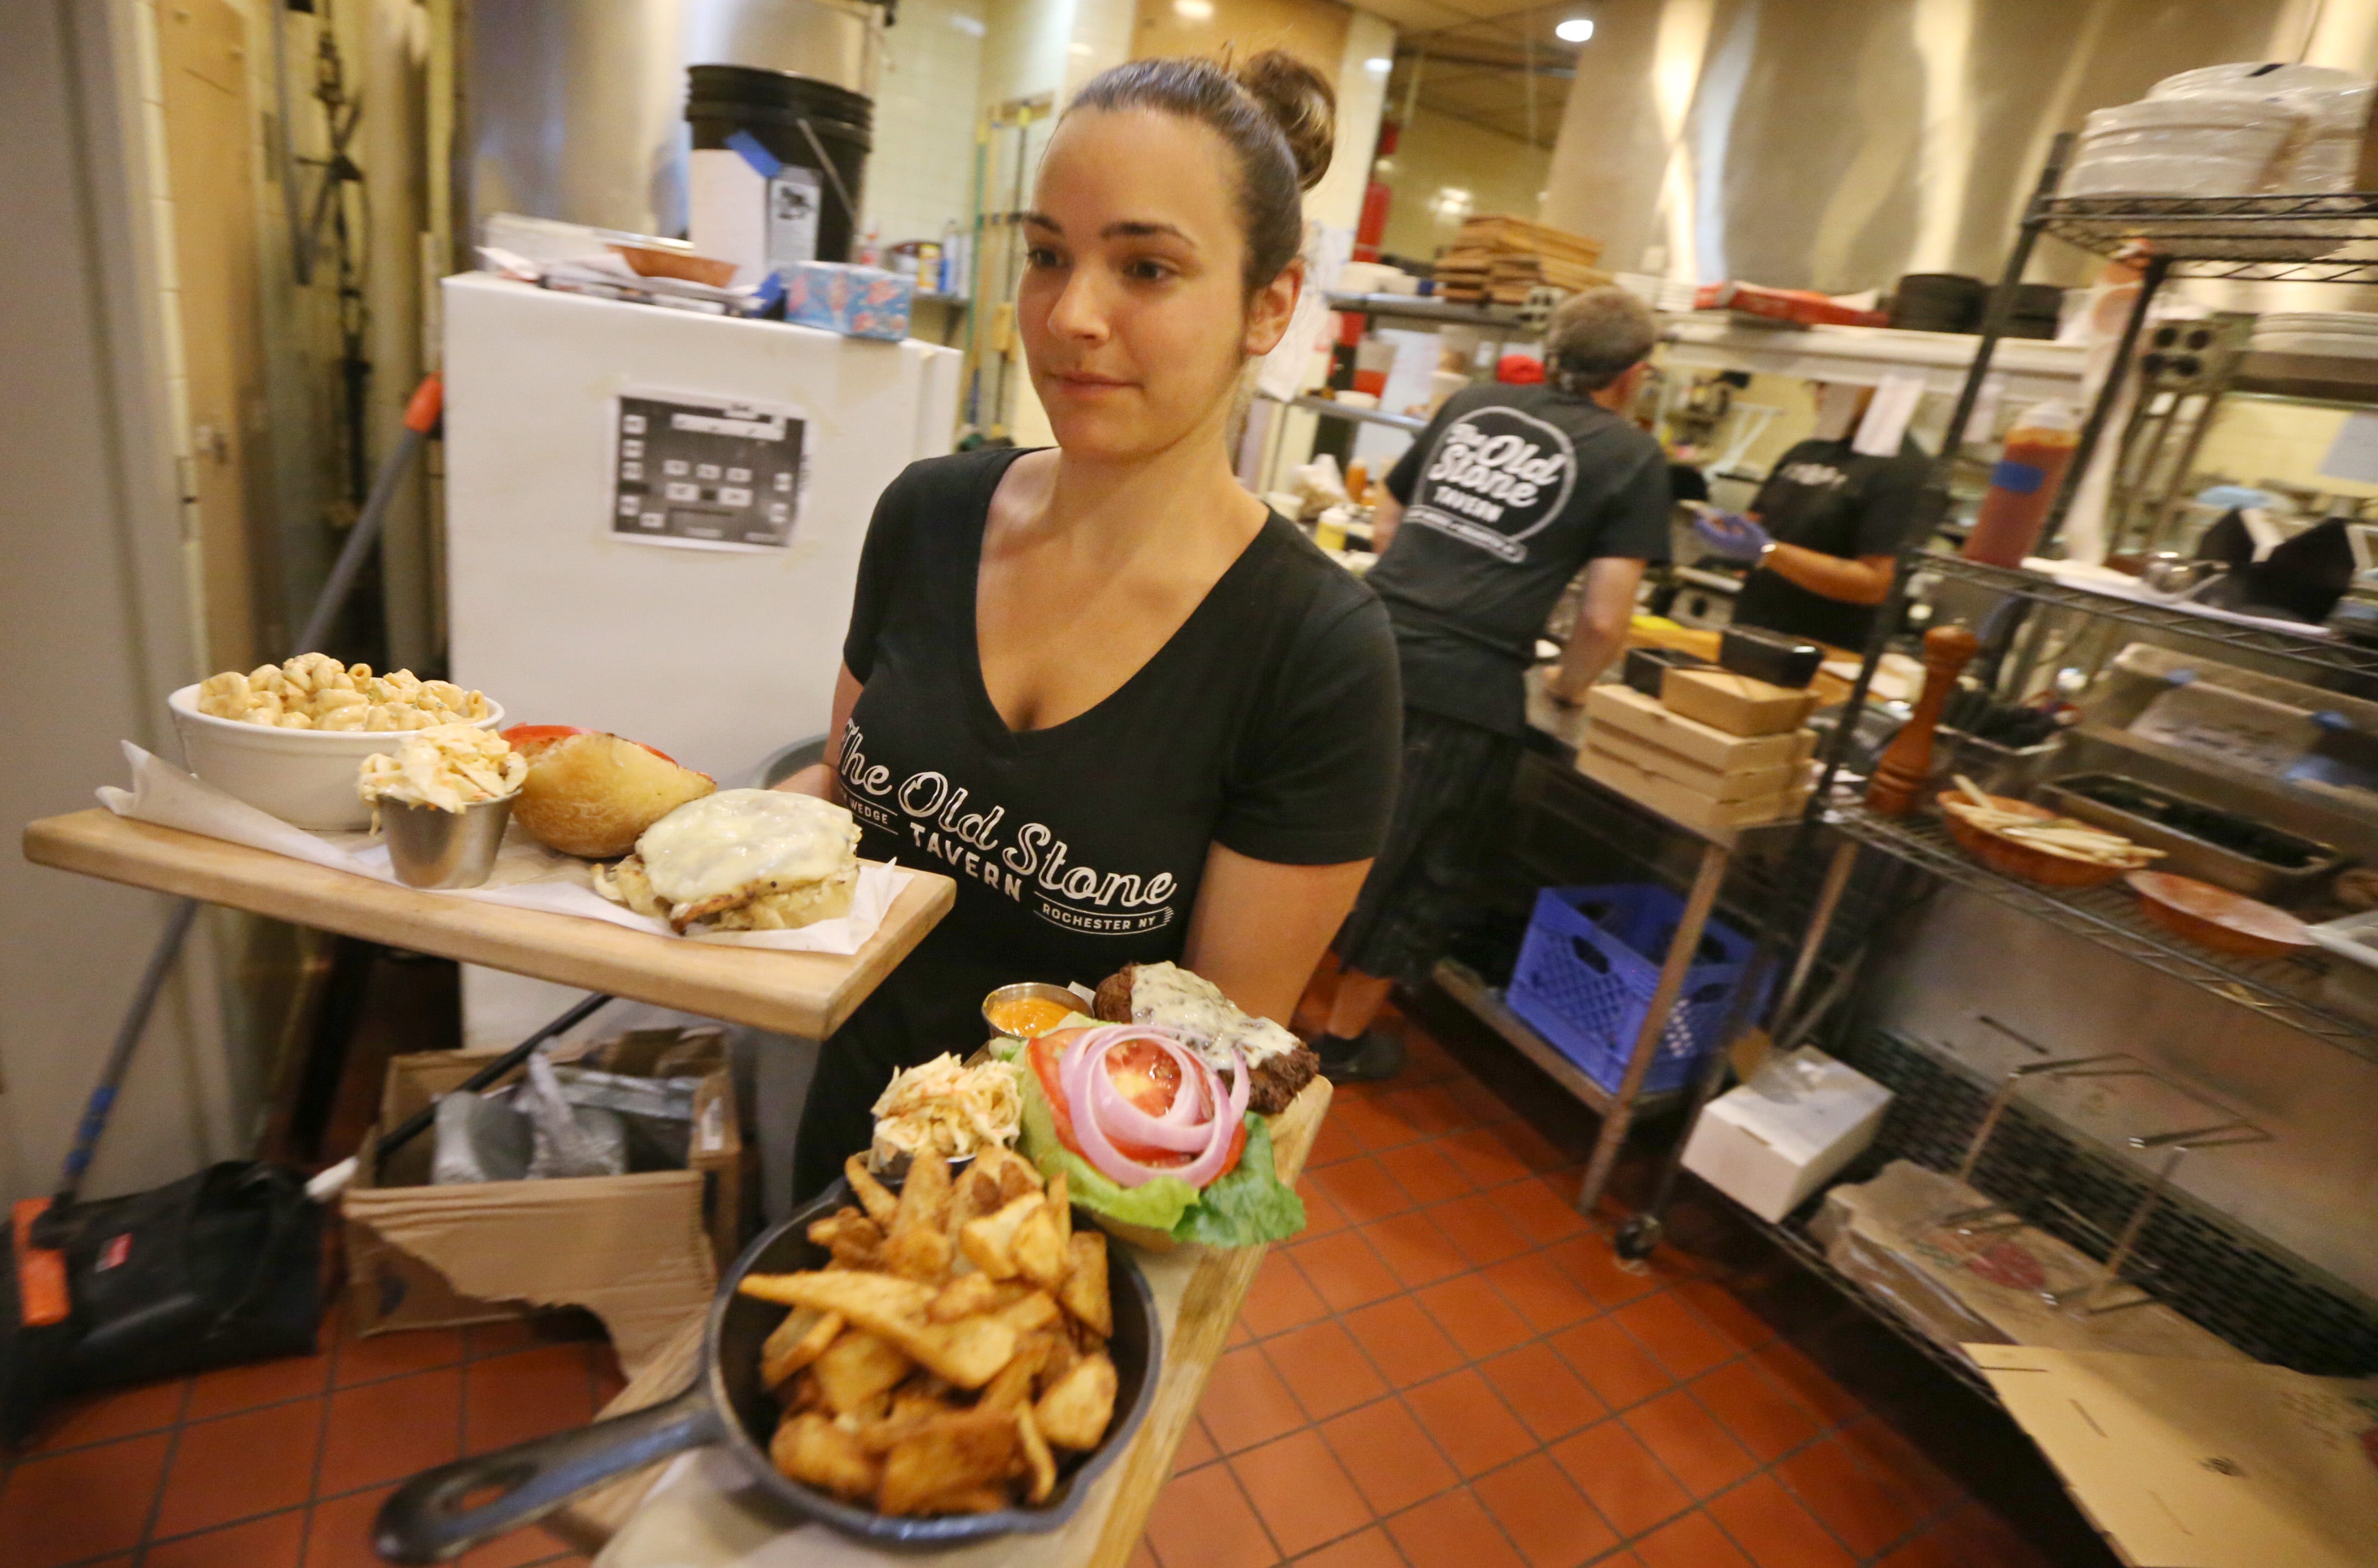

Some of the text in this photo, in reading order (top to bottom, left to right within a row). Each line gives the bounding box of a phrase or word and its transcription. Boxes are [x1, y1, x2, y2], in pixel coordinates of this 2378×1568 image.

[1428, 443, 1538, 507] Stone
[1477, 435, 1567, 486] Old
[840, 718, 1177, 906] The Old Stone
[850, 799, 888, 824] WEDGE
[910, 821, 1022, 902] TAVERN
[1042, 903, 1156, 930] ROCHESTER NY
